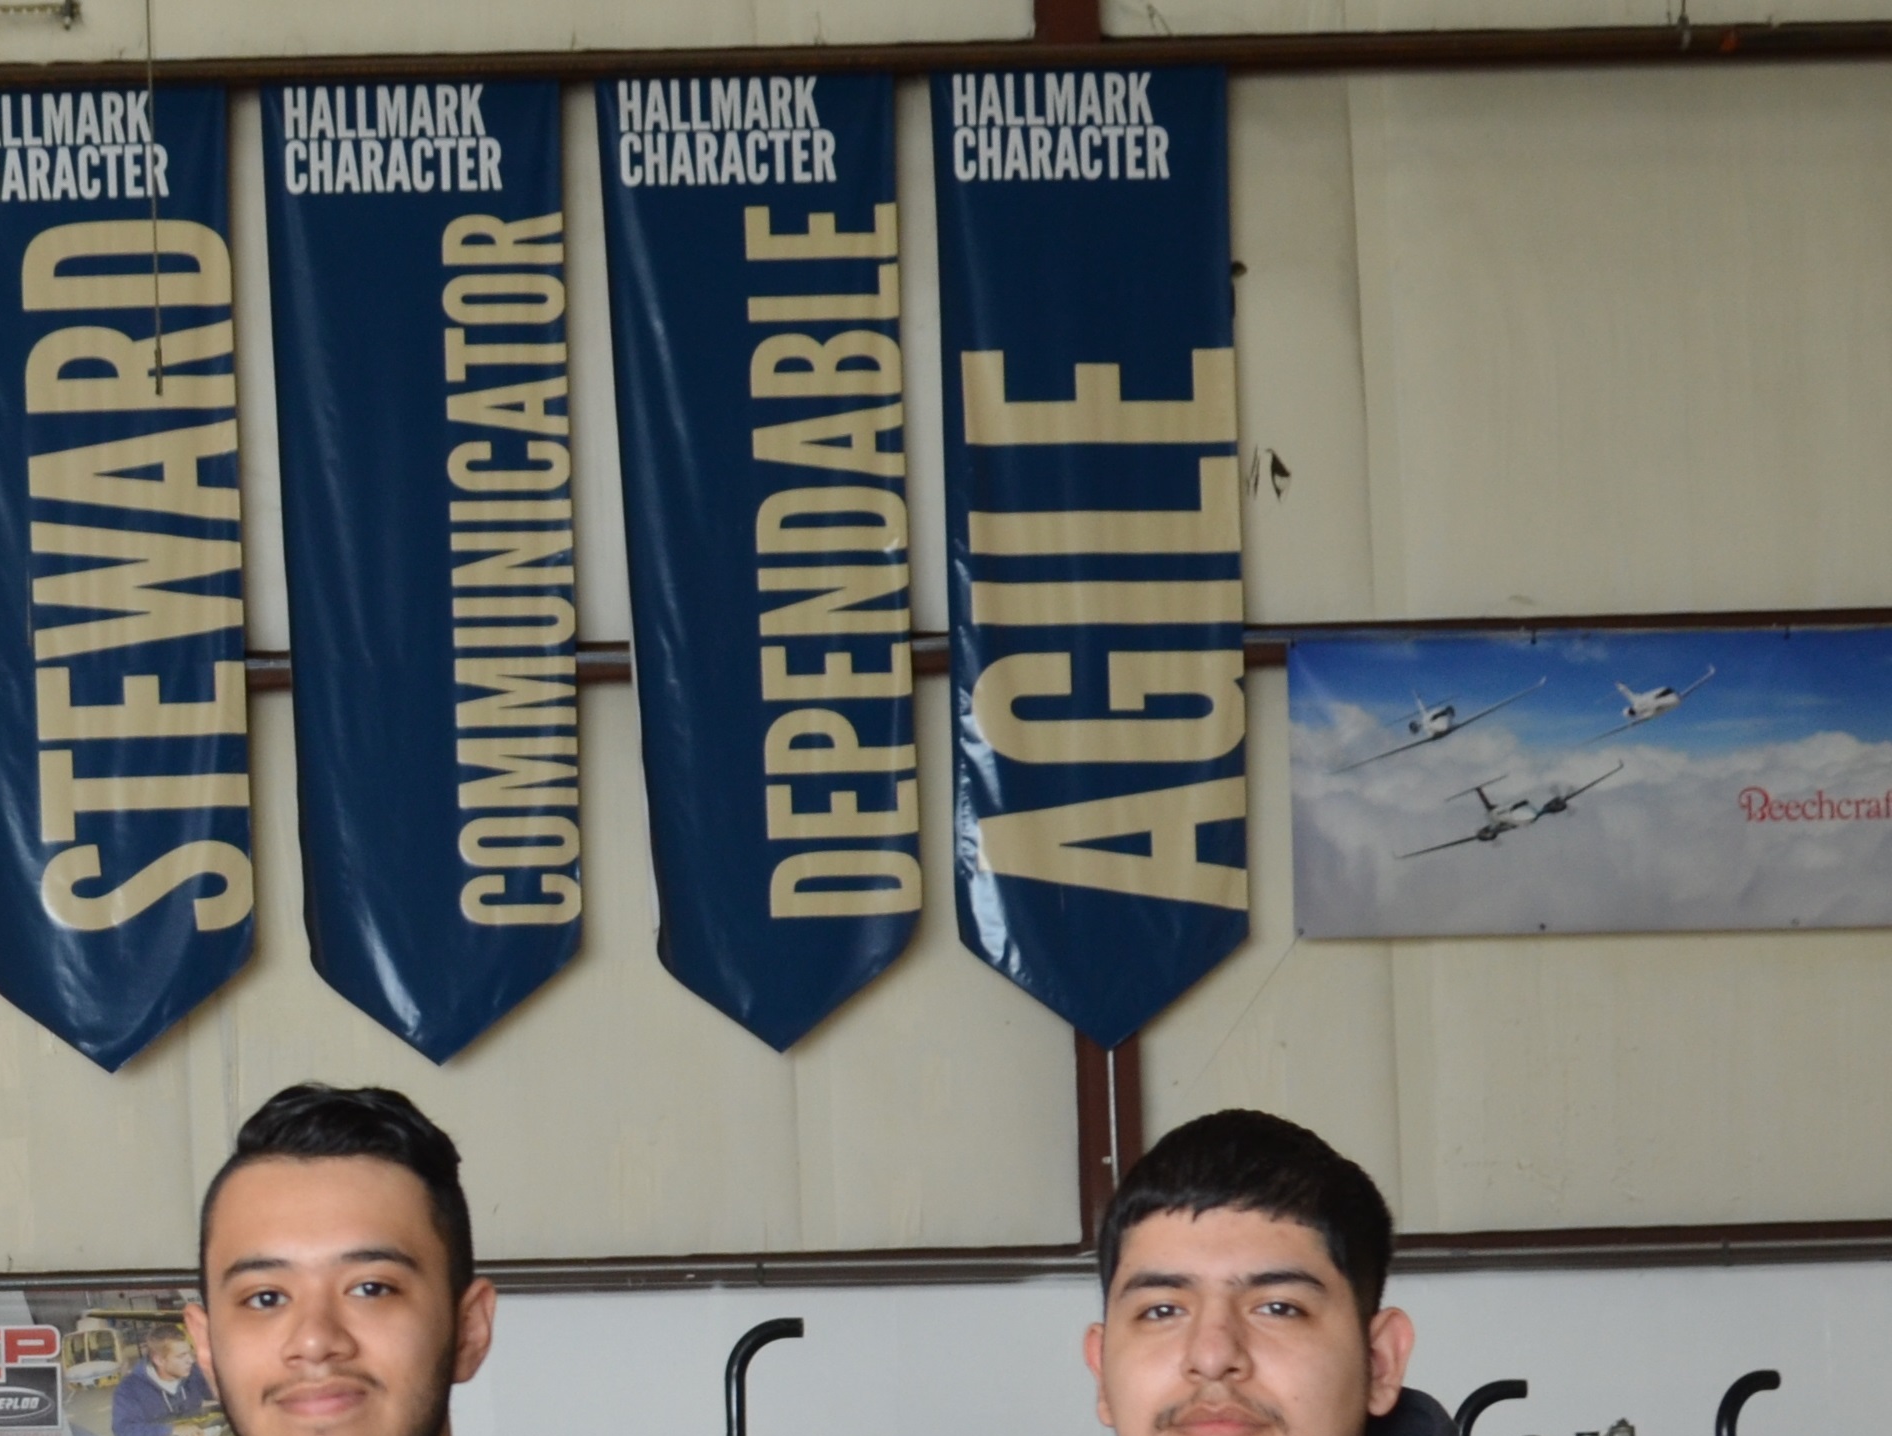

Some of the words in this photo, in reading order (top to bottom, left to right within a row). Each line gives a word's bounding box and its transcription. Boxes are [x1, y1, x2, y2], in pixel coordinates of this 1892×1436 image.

[283, 85, 485, 143] HALLMARK
[618, 77, 820, 135] HALLMARK
[952, 72, 1154, 130] HALLMARK
[284, 136, 503, 196] CHARACTER
[619, 126, 837, 189] CHARACTER
[953, 124, 1170, 182] CHARACTER
[20, 218, 254, 934] STEWARD
[440, 212, 583, 927] COMMUNICATOR
[743, 201, 923, 920] DEPENDABLE
[960, 347, 1250, 910] AGILE
